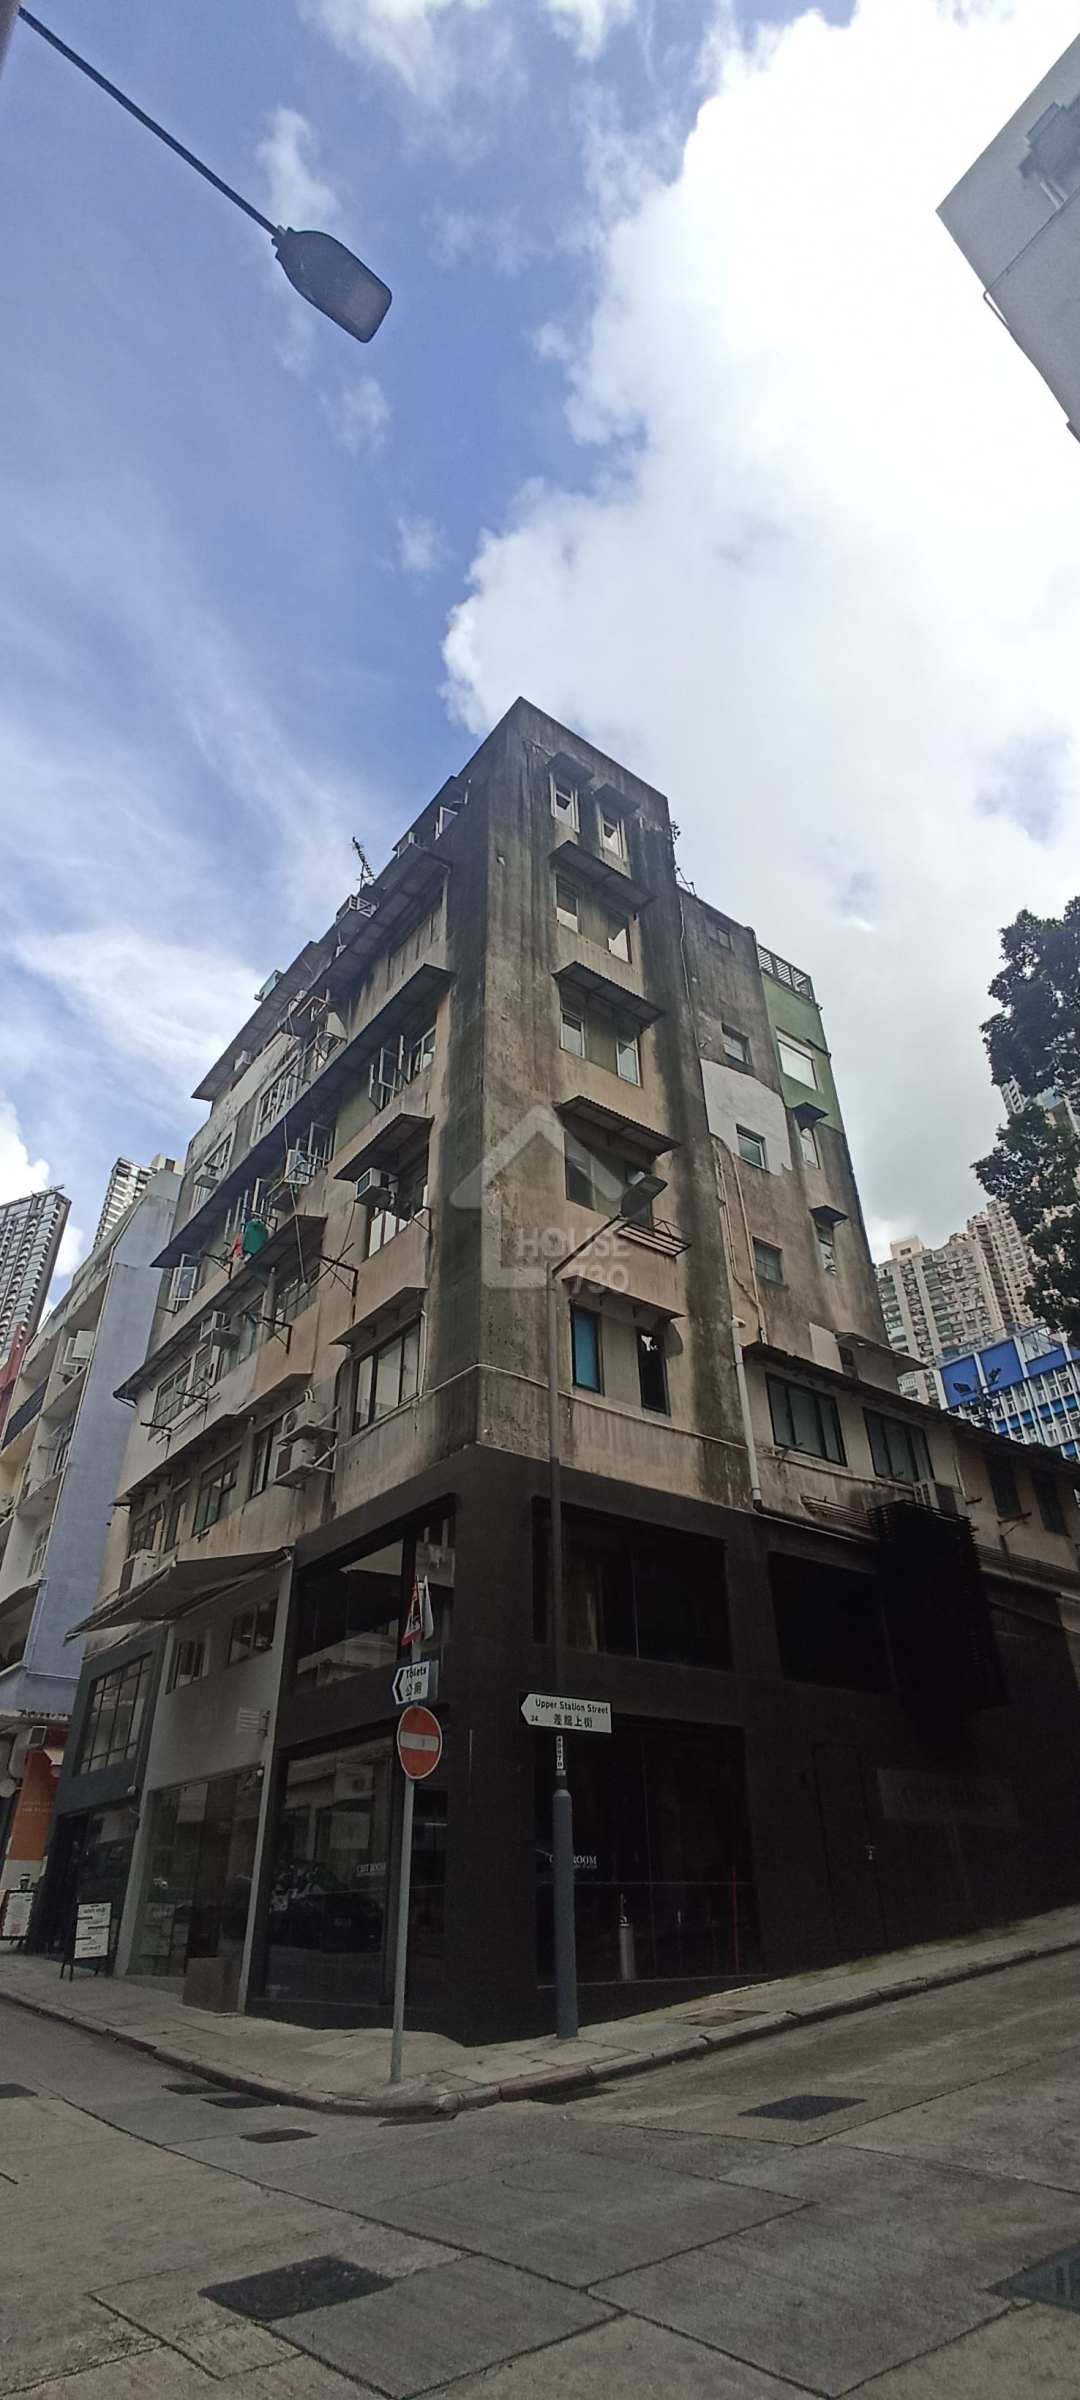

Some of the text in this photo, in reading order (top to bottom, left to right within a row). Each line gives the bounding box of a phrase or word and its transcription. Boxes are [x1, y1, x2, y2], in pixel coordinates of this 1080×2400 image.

[406, 1666, 426, 1678] Toilets
[535, 1698, 608, 1714] Upper Station Street
